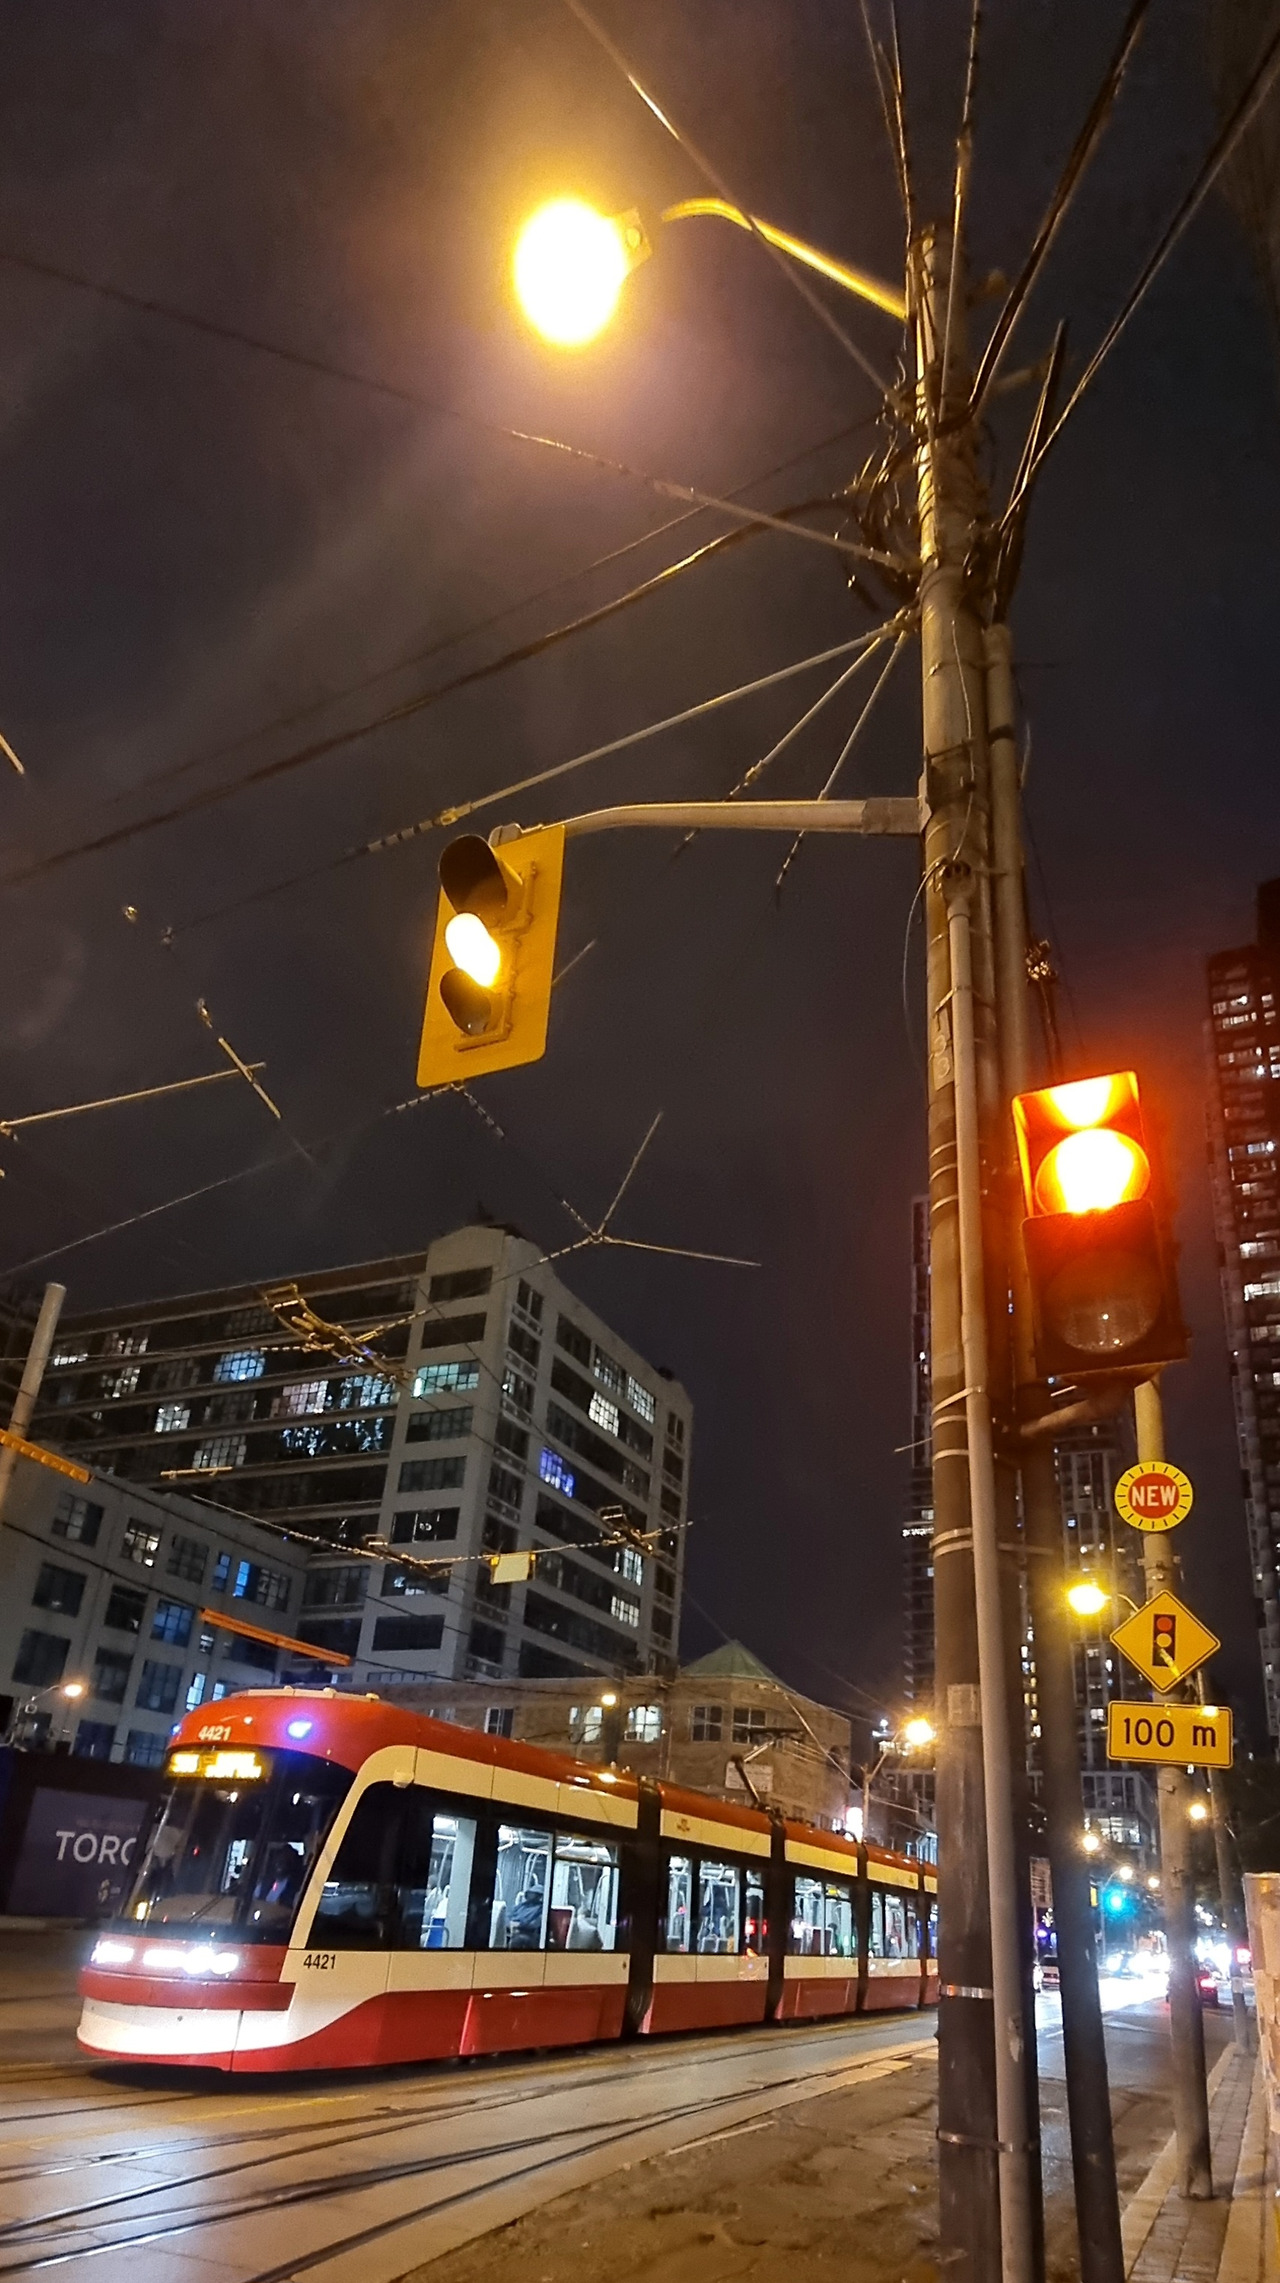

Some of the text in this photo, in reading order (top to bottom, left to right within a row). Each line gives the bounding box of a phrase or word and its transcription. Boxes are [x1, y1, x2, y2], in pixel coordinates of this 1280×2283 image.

[1131, 1485, 1177, 1507] NEW
[198, 1725, 232, 1742] 4421
[1123, 1717, 1217, 1748] 100 m
[303, 1954, 336, 1970] 4421
